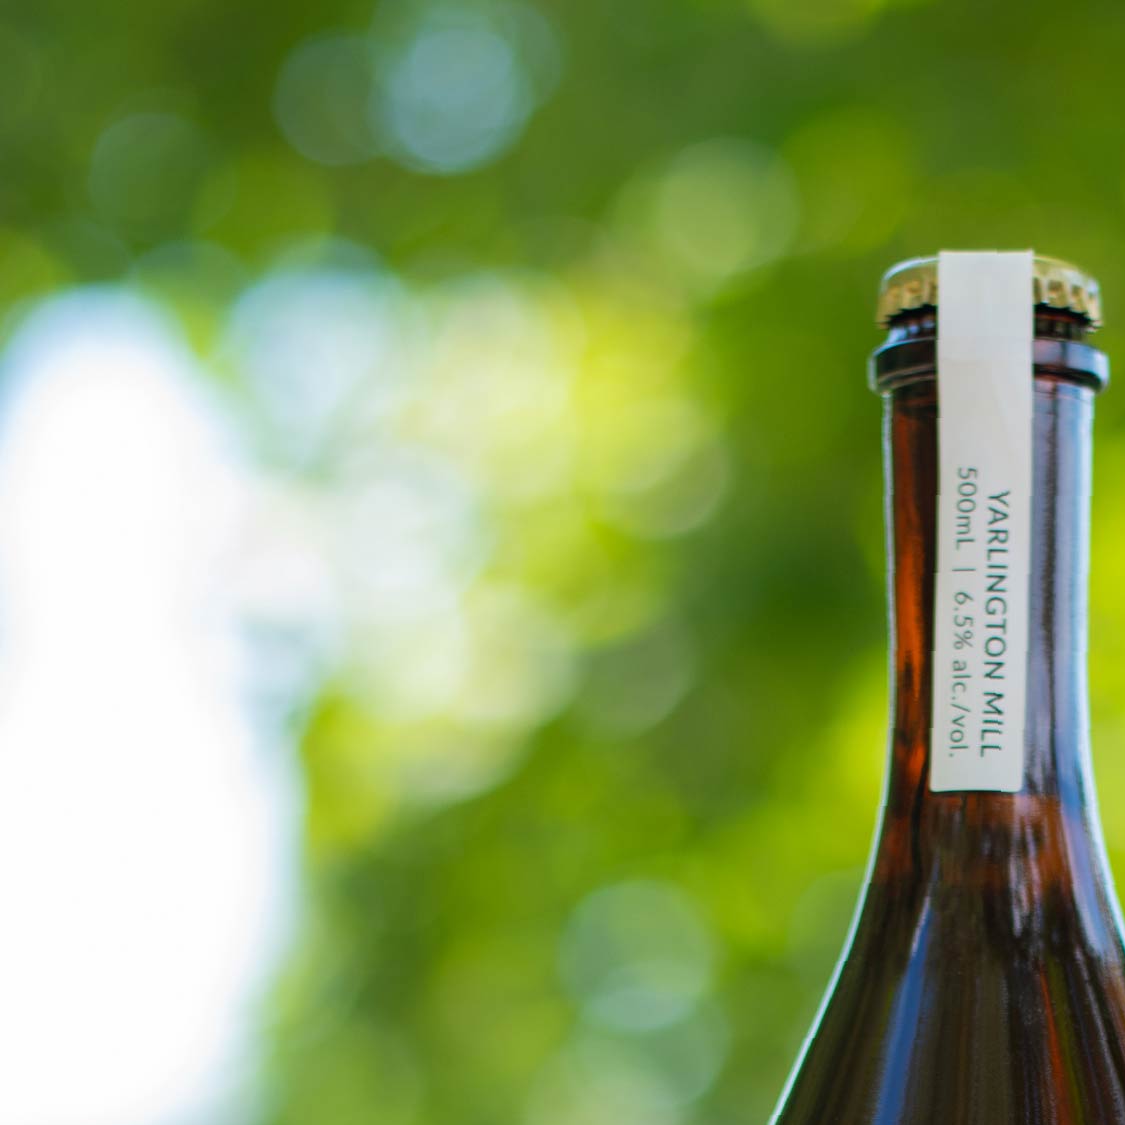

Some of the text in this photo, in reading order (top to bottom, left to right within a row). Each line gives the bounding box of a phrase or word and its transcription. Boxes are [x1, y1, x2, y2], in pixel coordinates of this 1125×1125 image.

[955, 466, 978, 551] 500mL
[953, 591, 974, 650] 6.5%
[980, 489, 1010, 758] YARLINGTON MILL
[948, 660, 972, 759] alc./vol.
